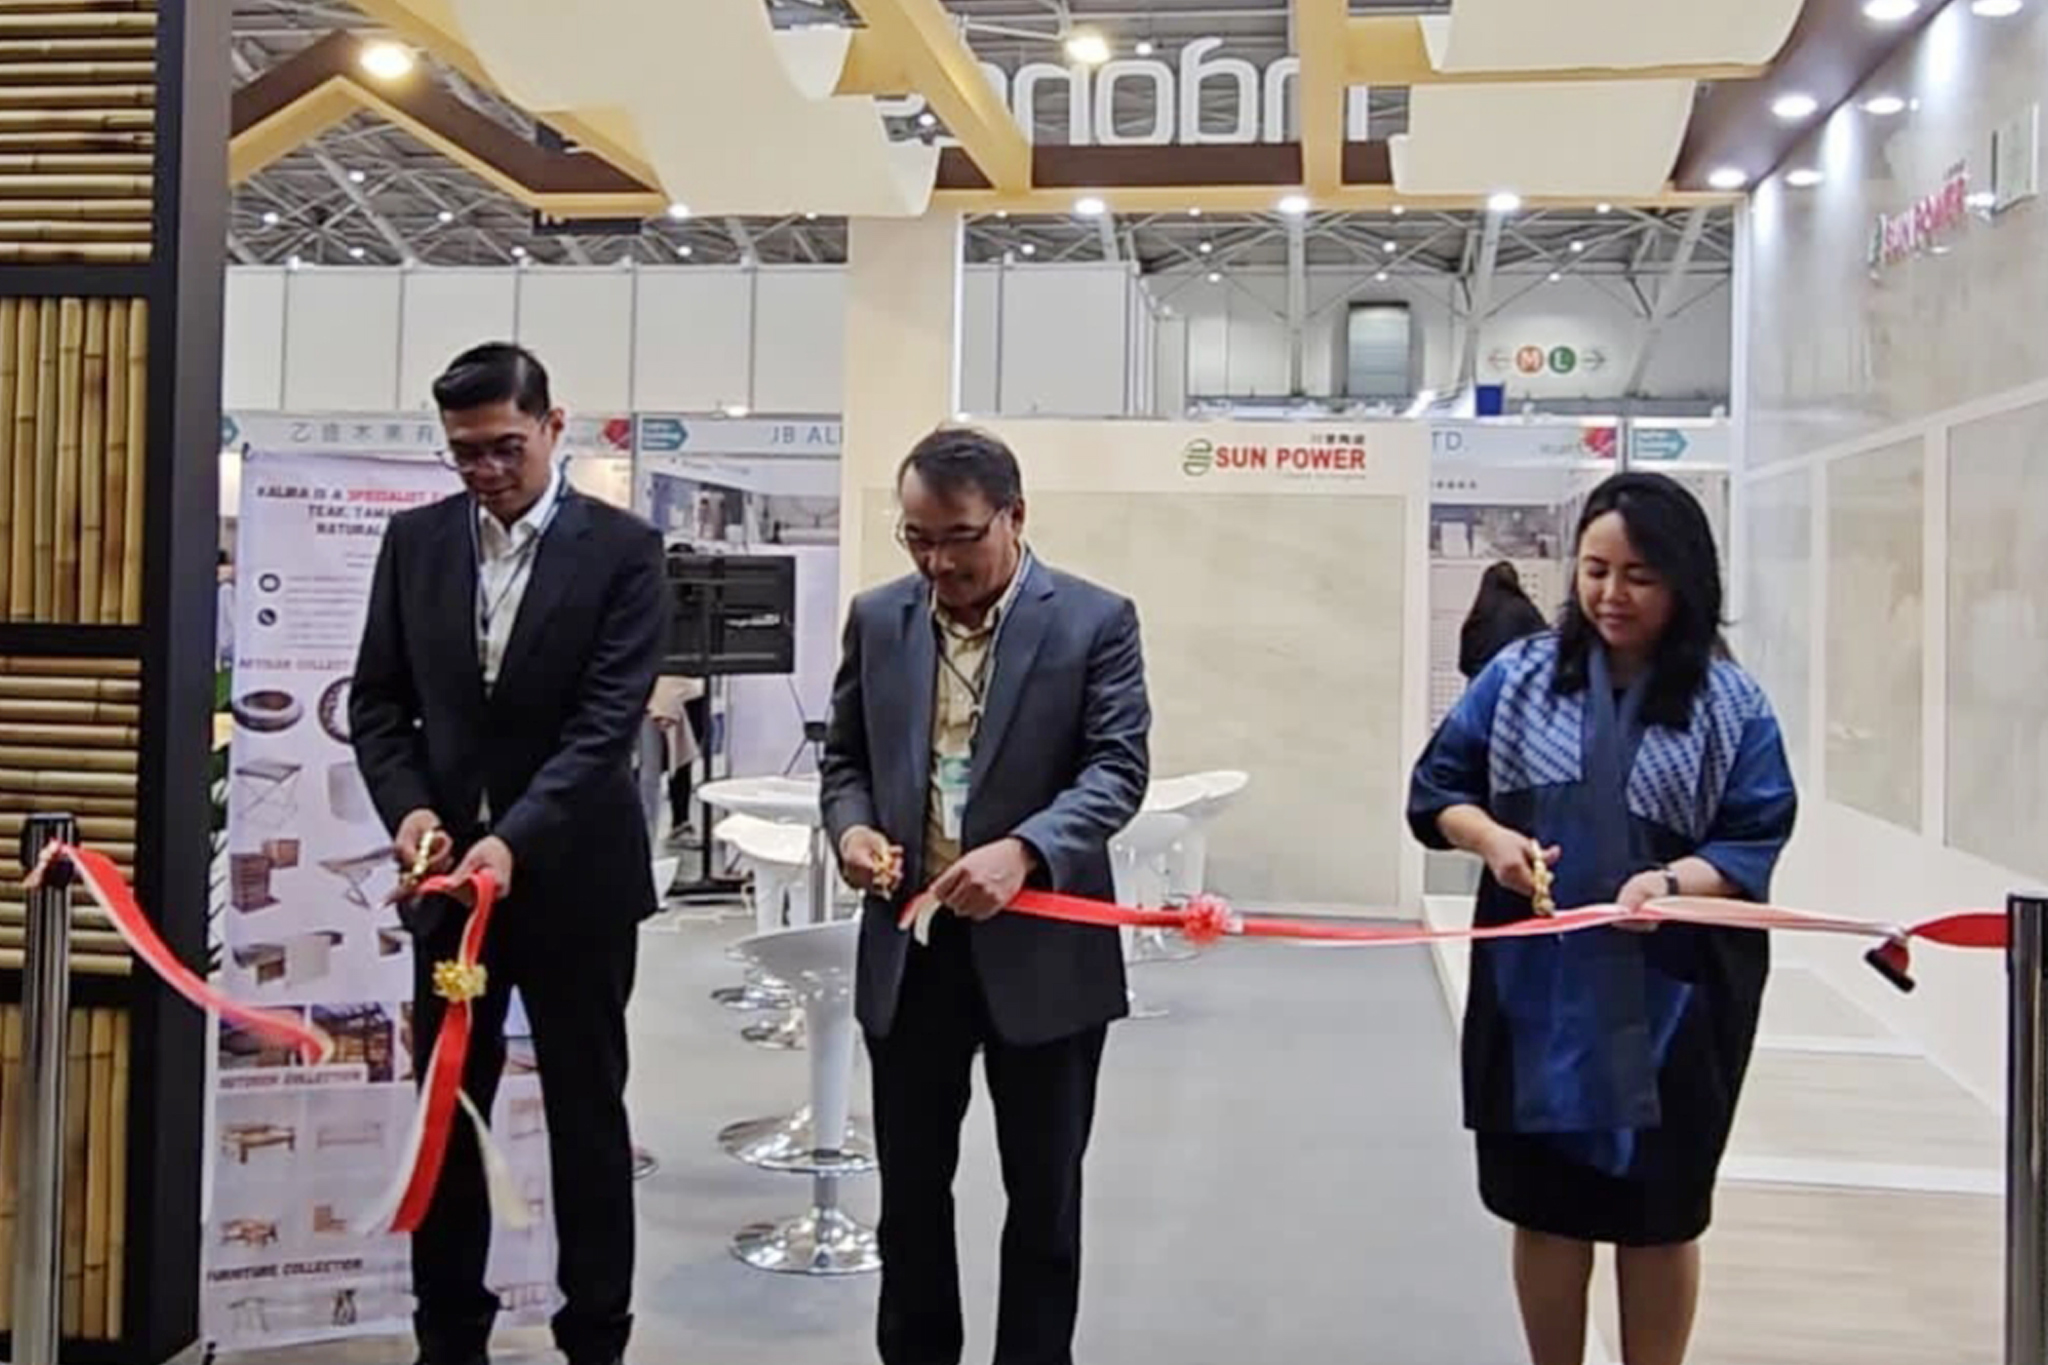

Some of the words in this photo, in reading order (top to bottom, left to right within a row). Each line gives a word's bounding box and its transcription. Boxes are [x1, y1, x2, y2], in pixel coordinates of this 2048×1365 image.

[1518, 349, 1542, 371] M
[771, 426, 795, 445] JB
[1216, 446, 1267, 469] SUN
[1276, 447, 1366, 469] POWER
[333, 488, 342, 500] A
[283, 1257, 364, 1276] COLLECTION
